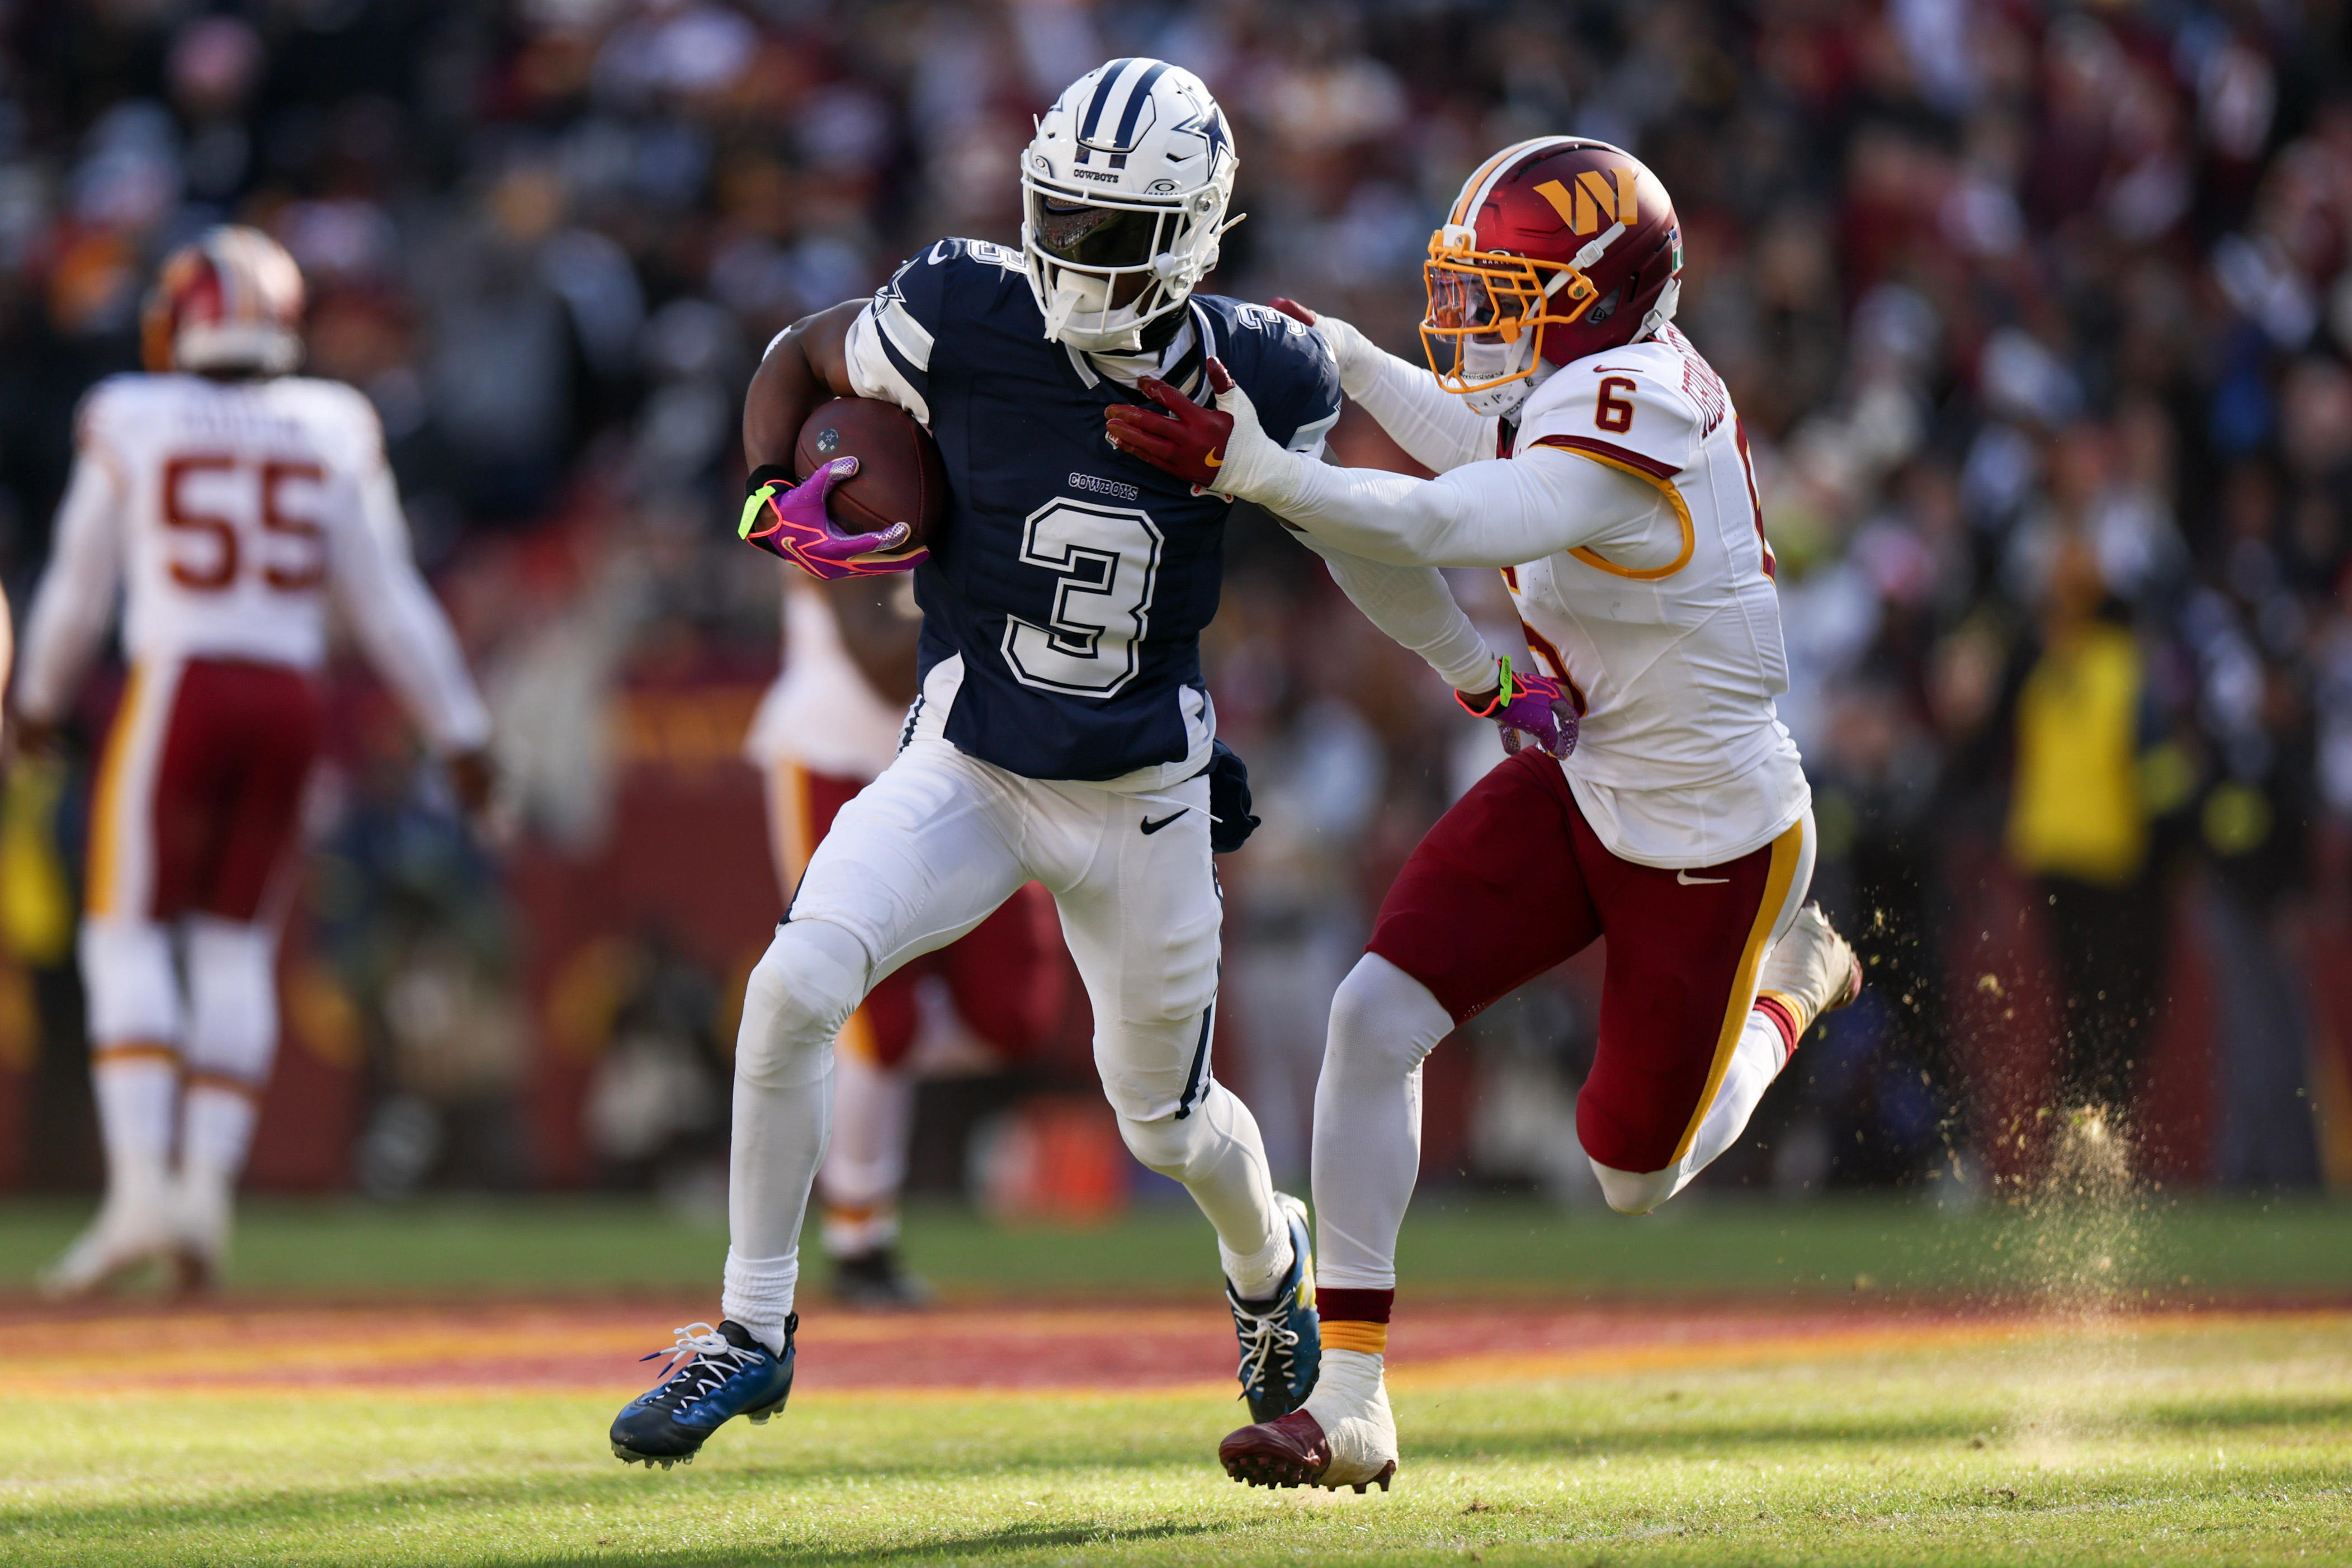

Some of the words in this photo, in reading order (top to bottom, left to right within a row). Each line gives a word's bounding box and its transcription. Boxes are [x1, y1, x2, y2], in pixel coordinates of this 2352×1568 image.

[1073, 169, 1119, 183] COWBOYS
[1594, 376, 1637, 434] 6
[1068, 472, 1139, 501] COWBOYS
[162, 456, 327, 592] 55
[1000, 495, 1165, 699] 3
